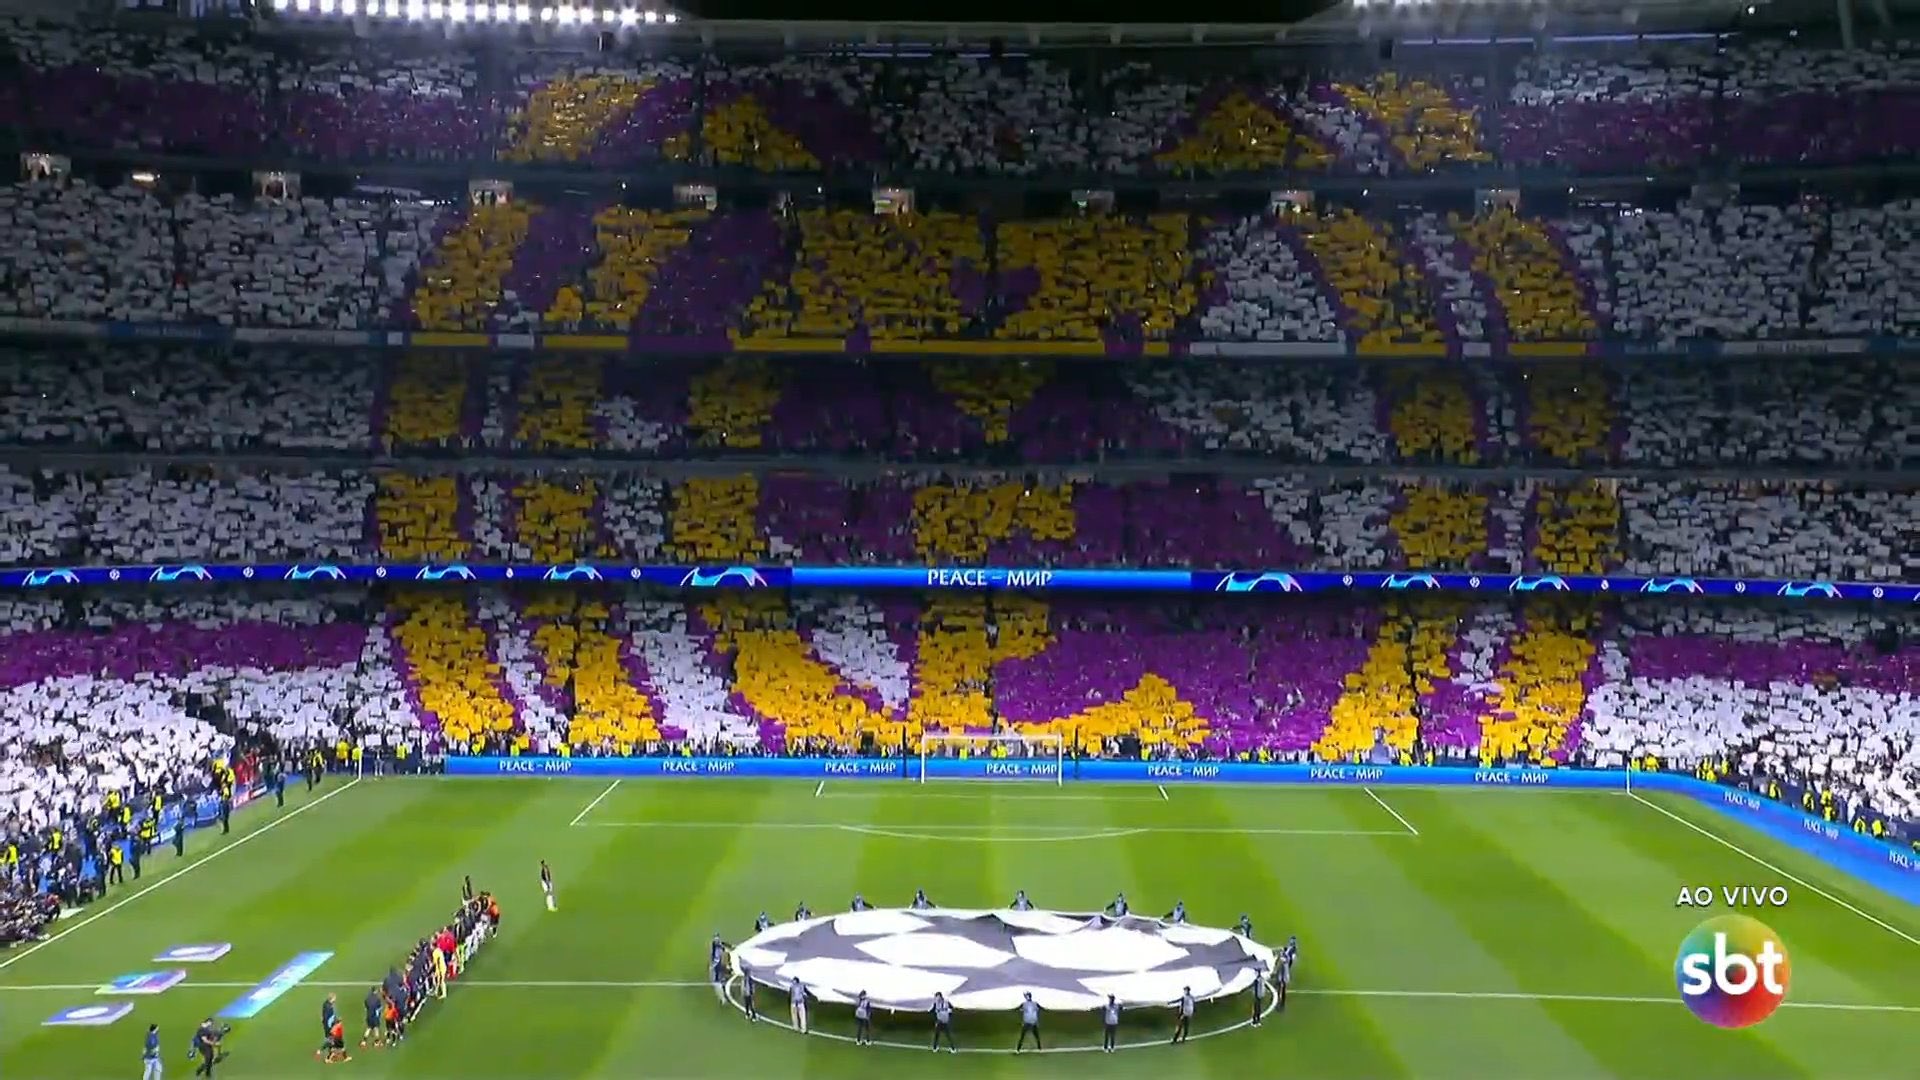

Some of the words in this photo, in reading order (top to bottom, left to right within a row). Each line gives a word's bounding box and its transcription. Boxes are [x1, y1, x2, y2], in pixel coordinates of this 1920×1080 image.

[927, 568, 988, 586] PEACE
[499, 760, 534, 771] PEACE
[662, 761, 697, 772] PEACE
[986, 763, 1021, 774] PEACE
[1148, 765, 1182, 776] PEACE
[1310, 768, 1345, 779] PEACE
[1475, 771, 1510, 783] PEACE
